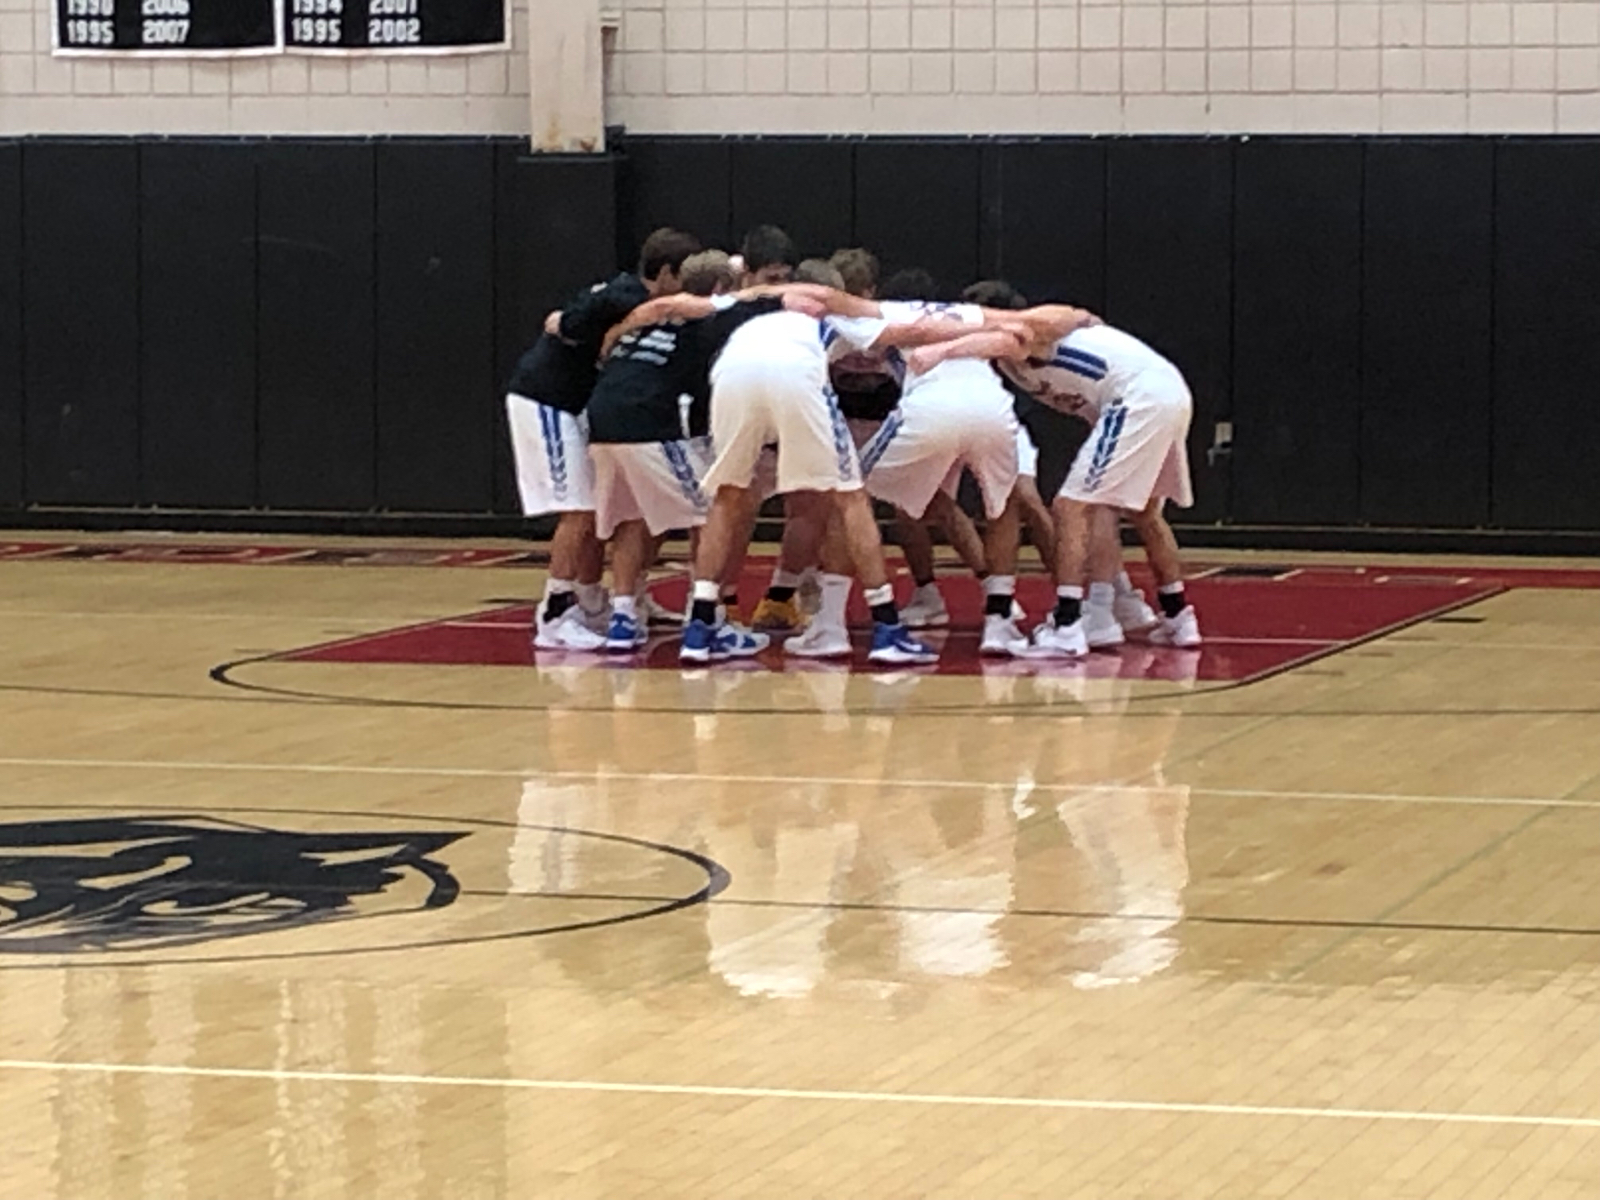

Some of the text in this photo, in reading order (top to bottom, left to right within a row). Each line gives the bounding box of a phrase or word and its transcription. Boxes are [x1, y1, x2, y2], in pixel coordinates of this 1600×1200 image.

[67, 19, 114, 44] 1995
[142, 19, 190, 44] 2007
[292, 17, 342, 43] 1995
[368, 18, 421, 43] 2002
